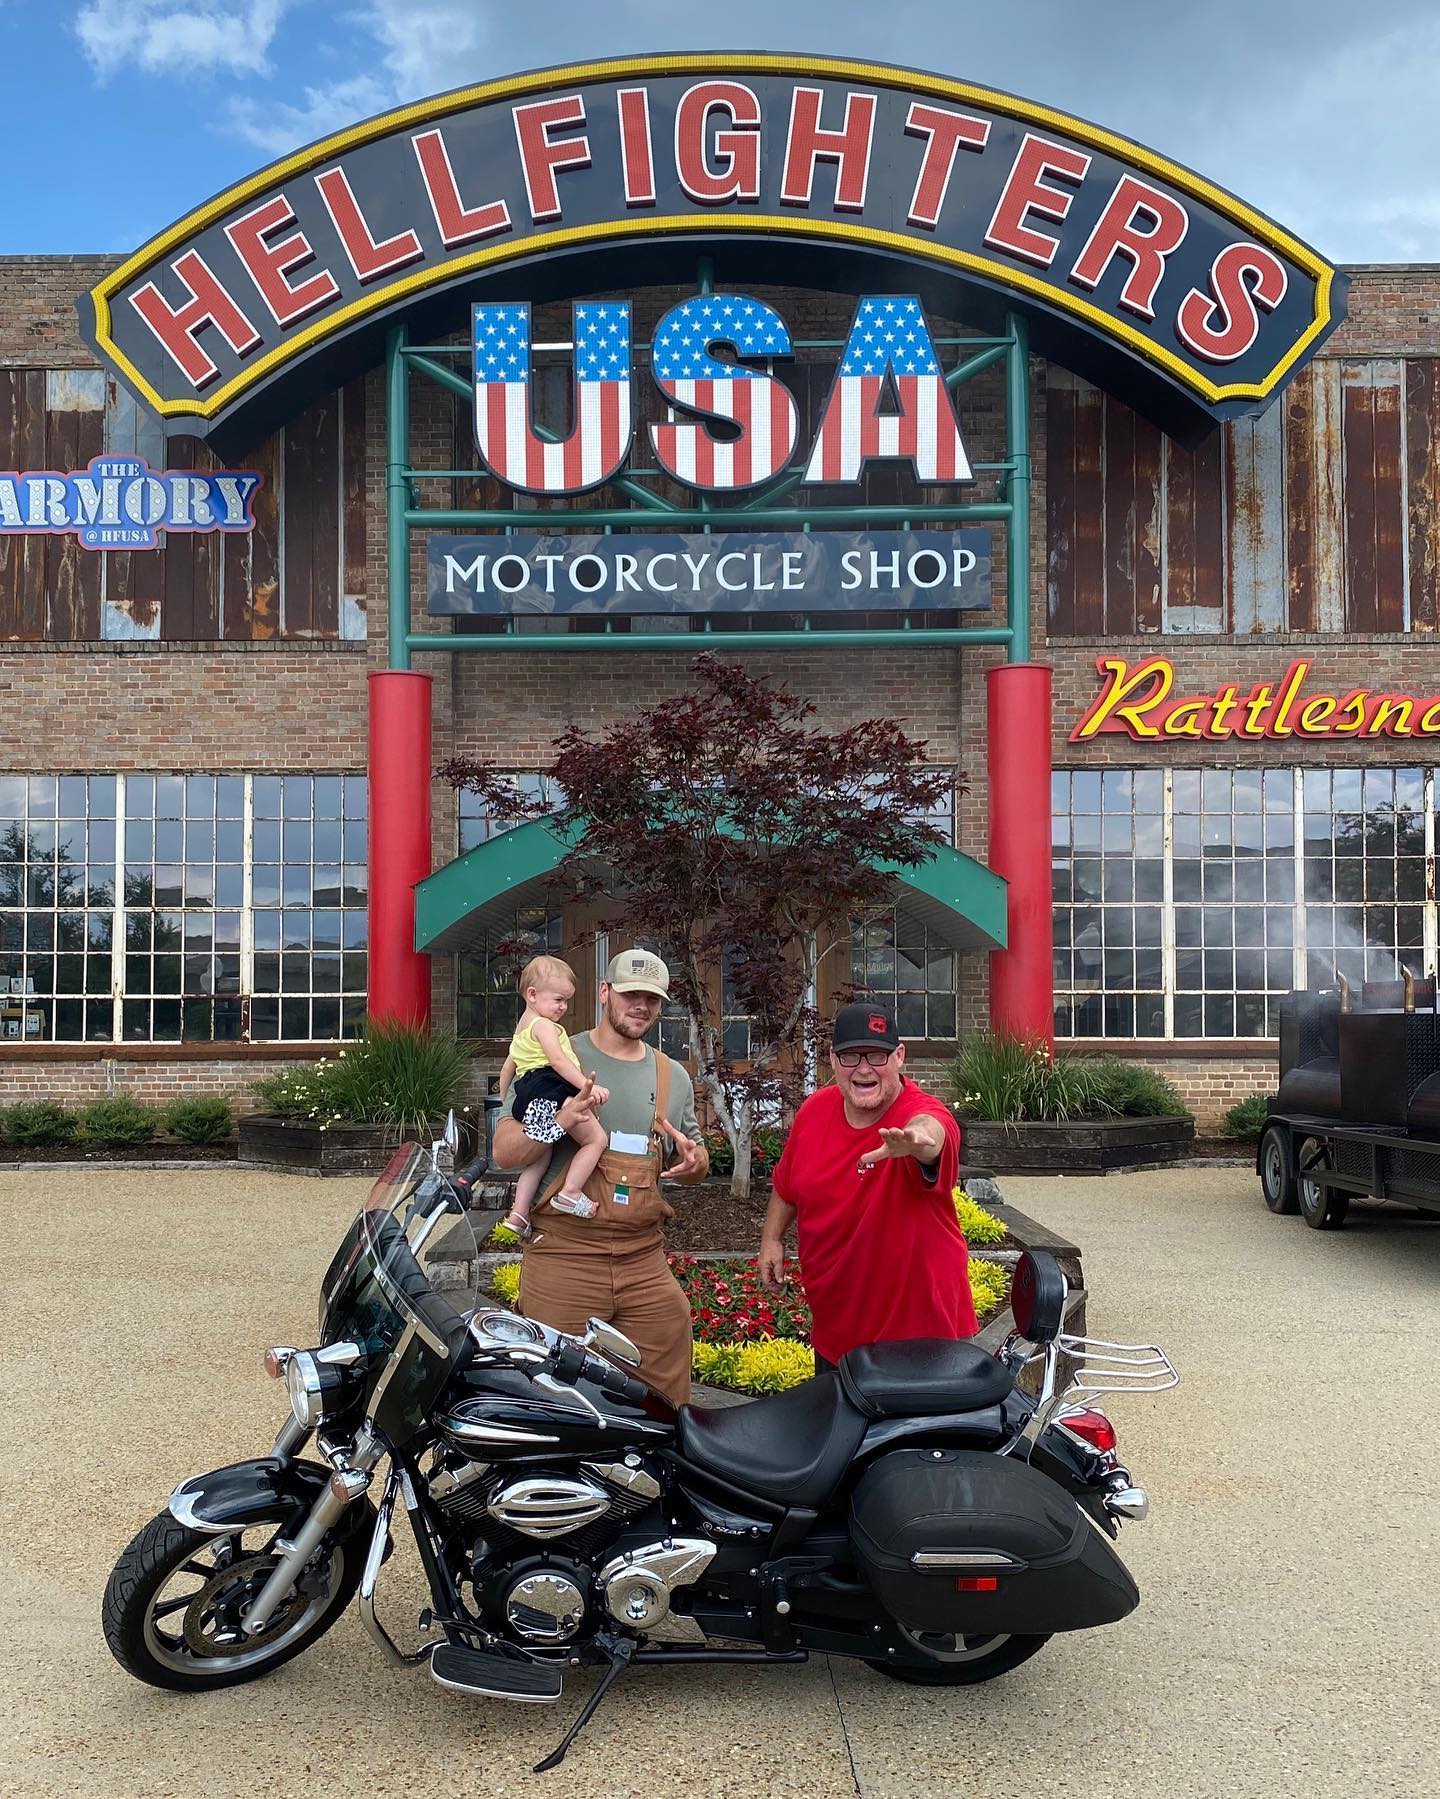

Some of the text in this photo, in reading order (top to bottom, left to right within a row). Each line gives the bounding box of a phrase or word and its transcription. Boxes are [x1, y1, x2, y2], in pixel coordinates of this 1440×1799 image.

[127, 79, 1289, 391] HELLFIGHTERS
[471, 293, 977, 497] USA
[98, 463, 140, 477] THE
[0, 477, 257, 526] ARMORY
[86, 530, 150, 543] @ HFUSA
[443, 549, 978, 594] MOTORCYCLE SHOP
